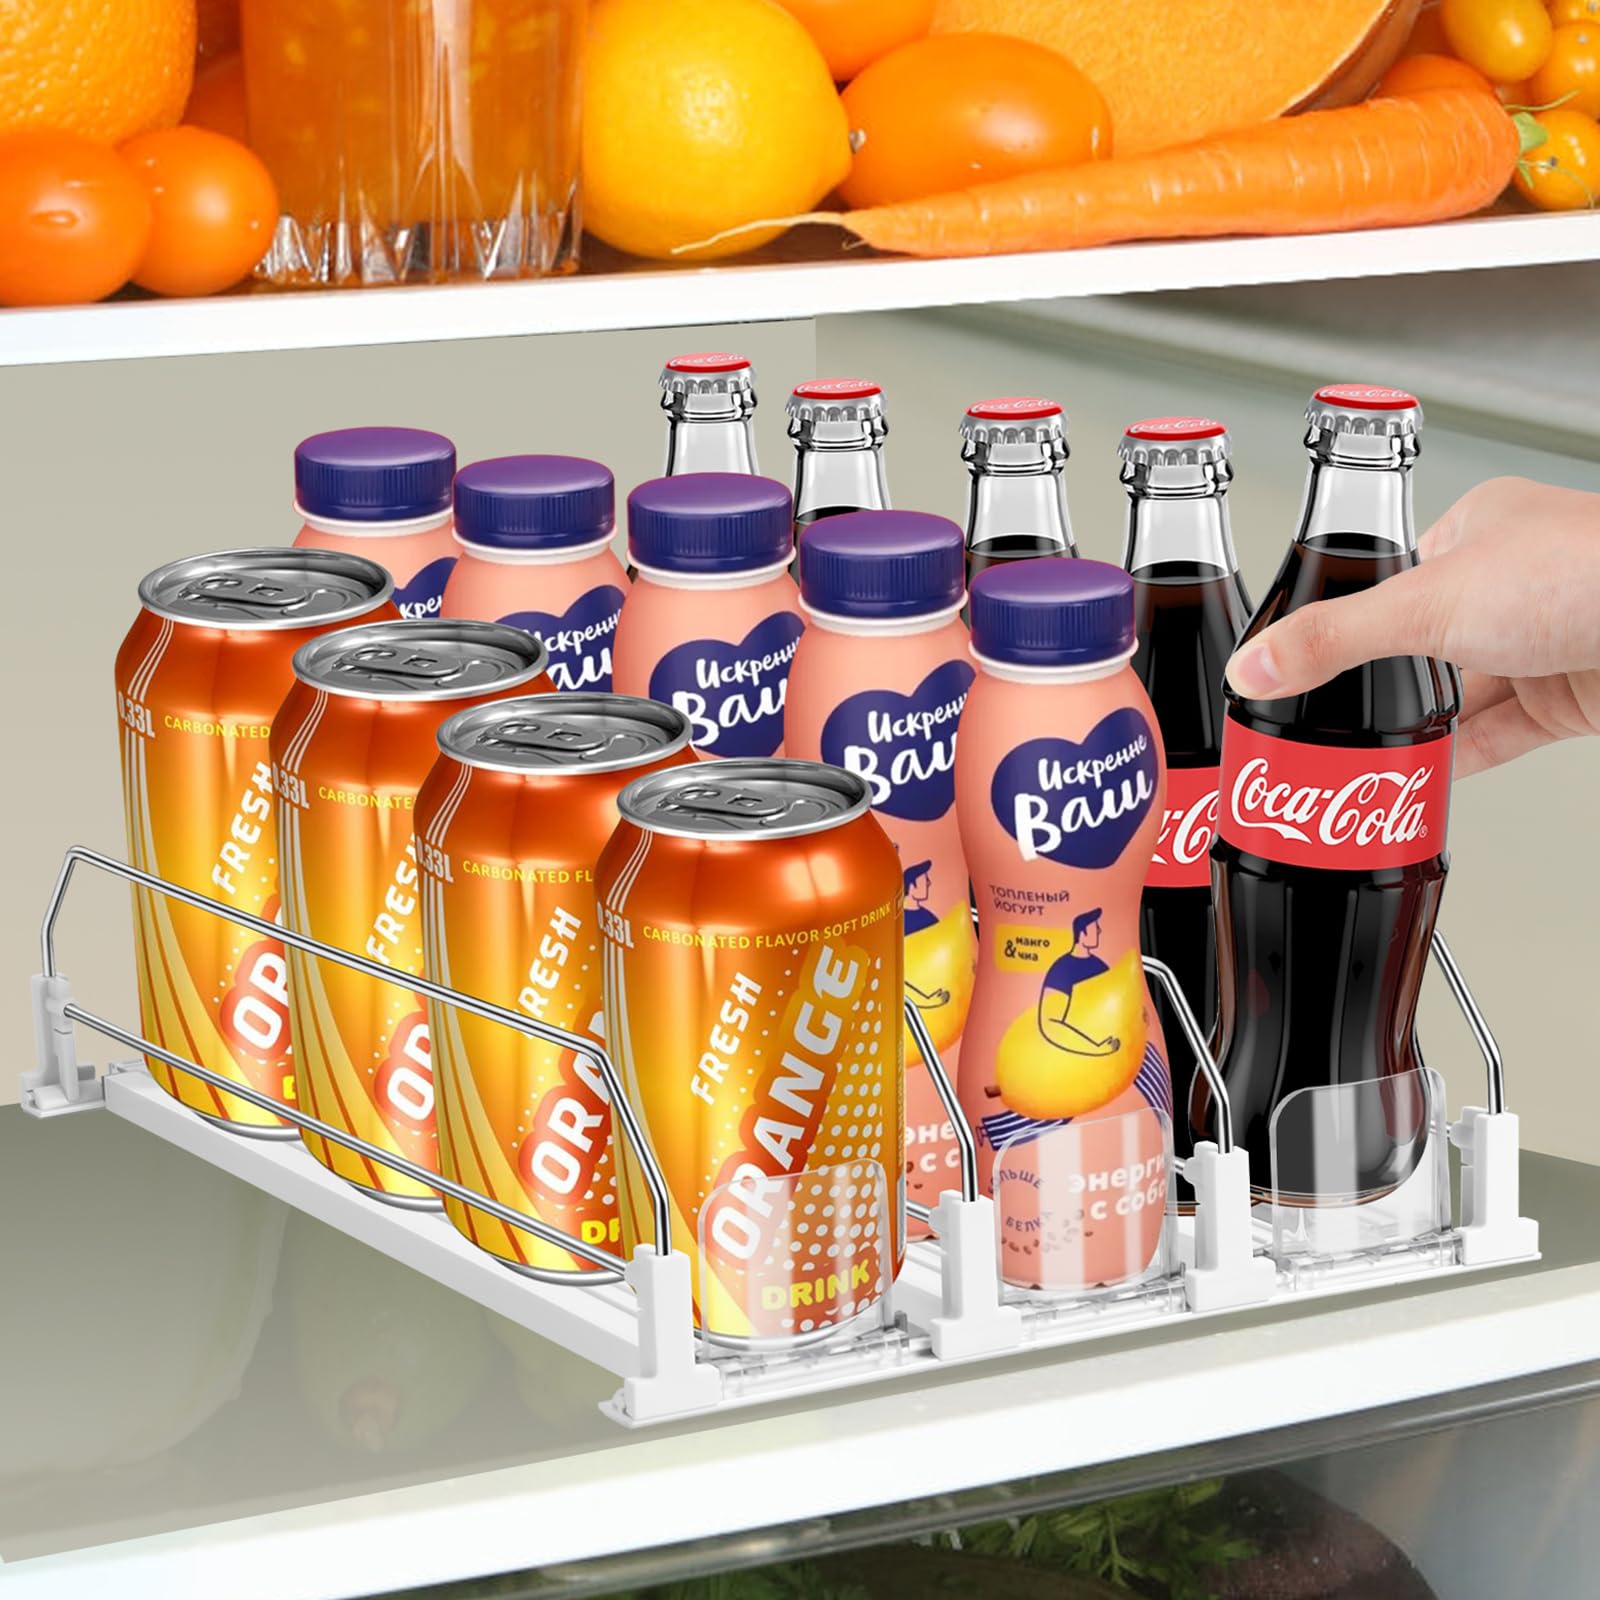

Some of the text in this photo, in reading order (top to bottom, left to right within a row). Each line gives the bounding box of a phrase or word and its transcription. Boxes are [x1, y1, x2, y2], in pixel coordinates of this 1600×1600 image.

[696, 636, 800, 689] Искренн
[163, 714, 271, 739] CARBONATED
[1038, 734, 1148, 791] Искренне
[318, 786, 417, 810] CARBONATE
[1014, 770, 1153, 862] Ваш
[1231, 757, 1434, 847] Coca-Cola
[462, 859, 570, 884] CARBONATED
[989, 884, 1071, 904] ТОПЛЕНЫЙ
[642, 901, 893, 950] CARBONATED FLAVOR SOFT DRINK
[994, 897, 1046, 917] ЙОГУРТ
[513, 905, 582, 1040] RESH
[690, 971, 763, 1105] FRESH
[711, 945, 860, 1259] ORANGE
[760, 1259, 870, 1312] DRINK
